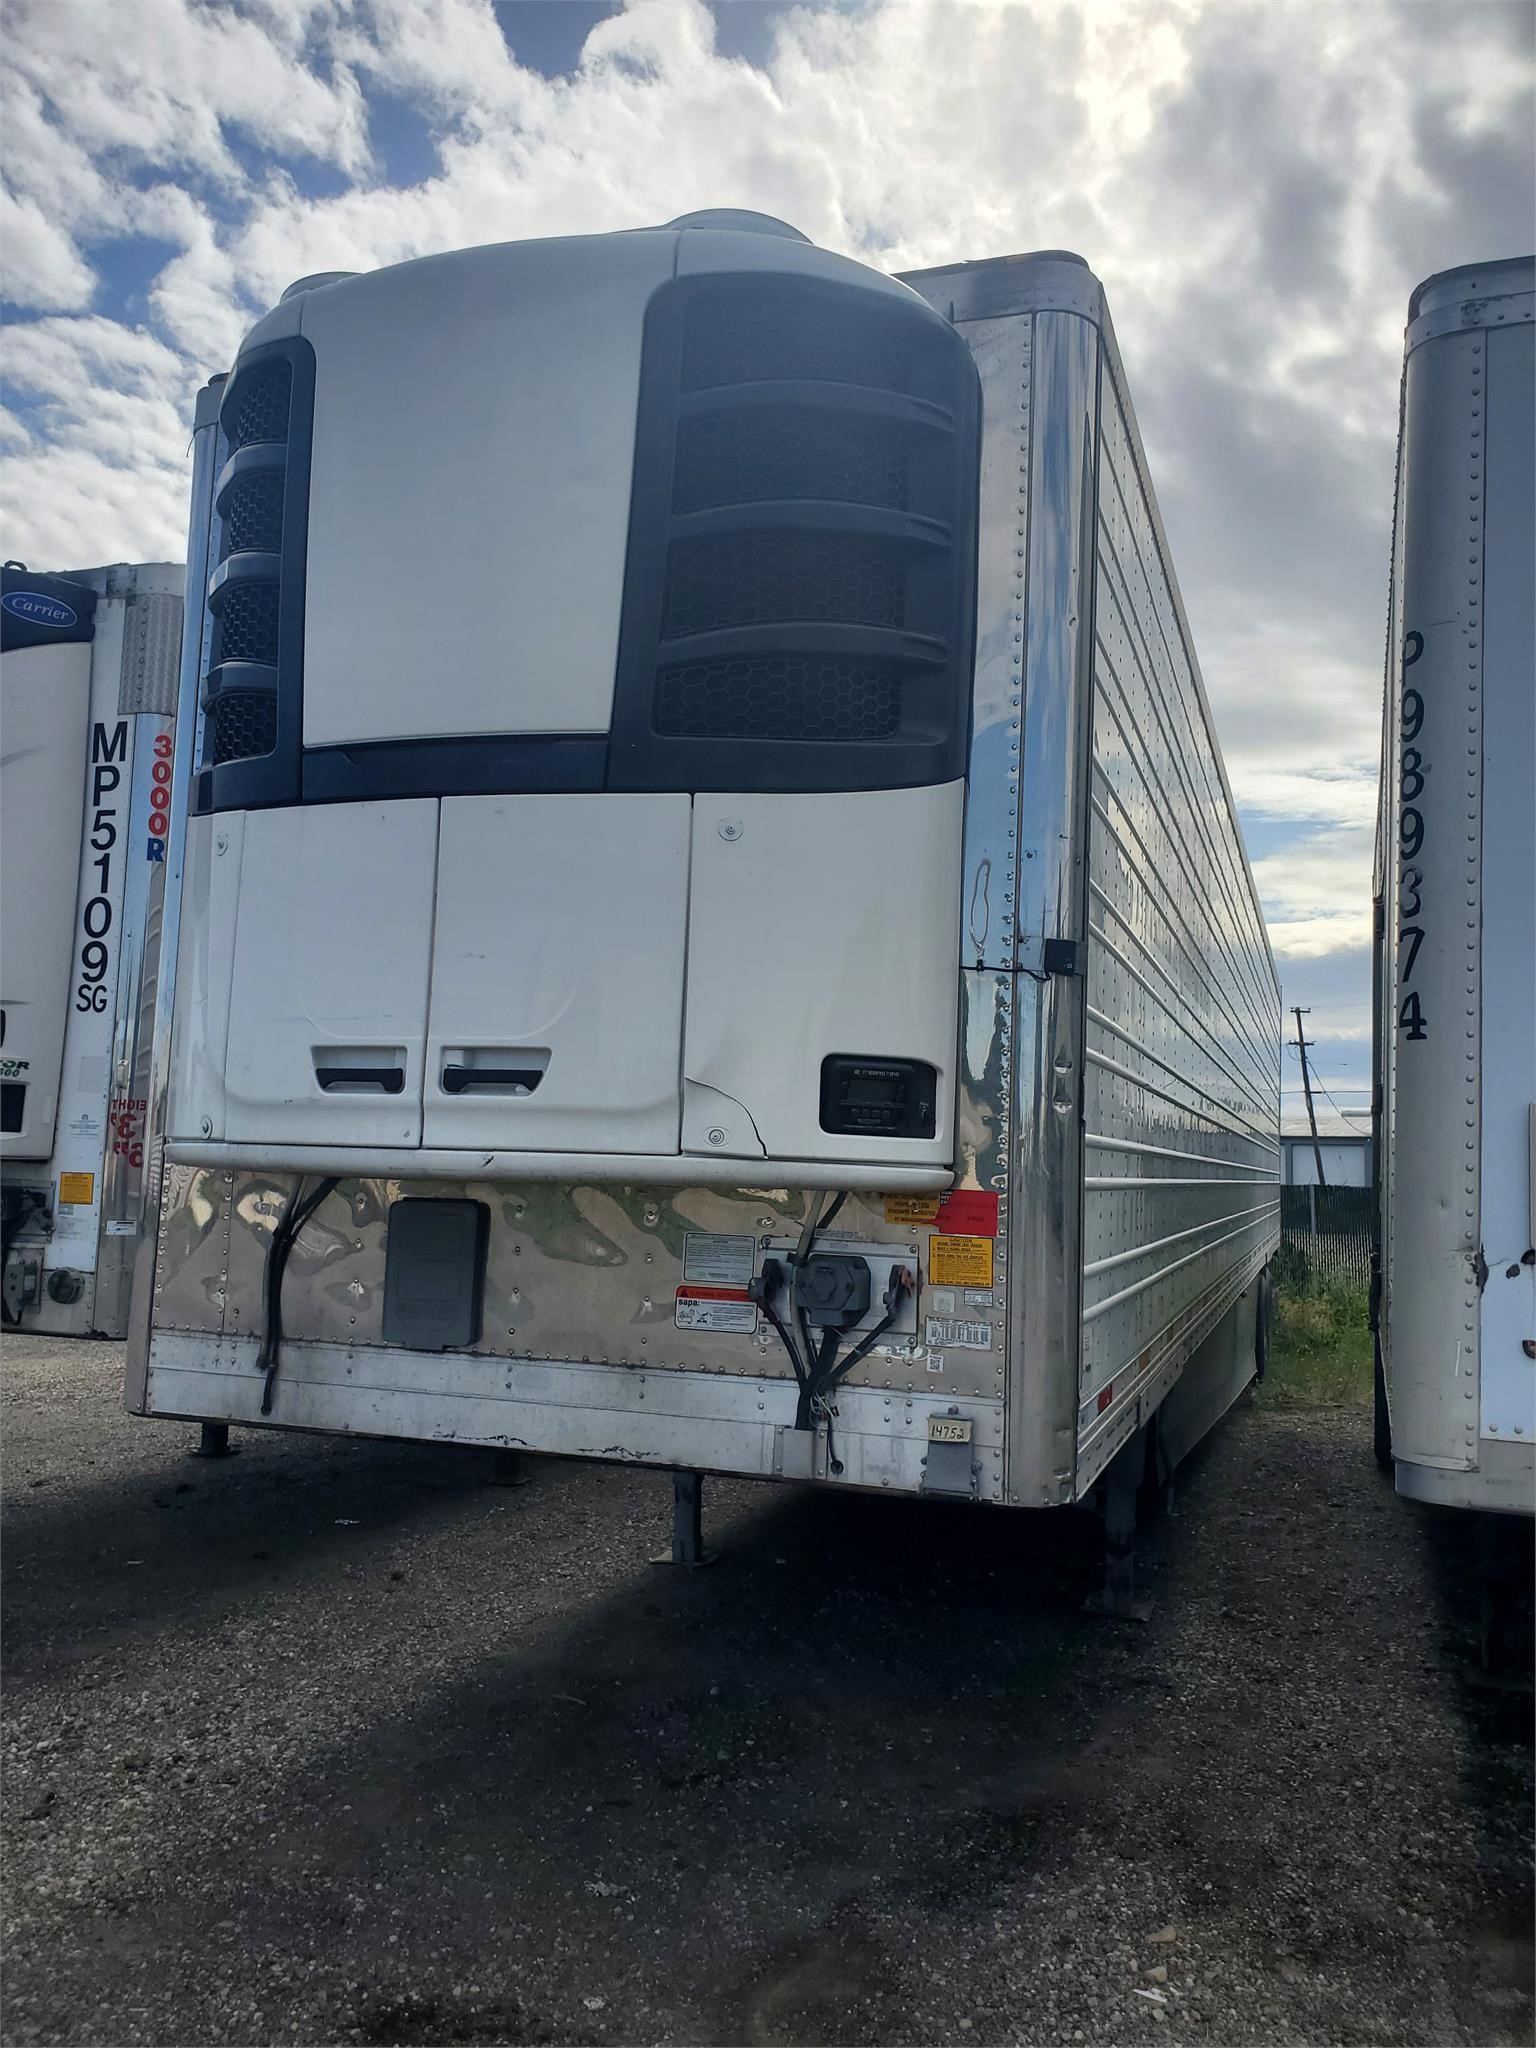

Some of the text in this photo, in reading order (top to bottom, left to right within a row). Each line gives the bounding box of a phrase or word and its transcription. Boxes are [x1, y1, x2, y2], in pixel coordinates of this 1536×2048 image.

[11, 597, 70, 621] Carrier
[0, 1060, 30, 1070] OR
[931, 1424, 965, 1440] 14752
